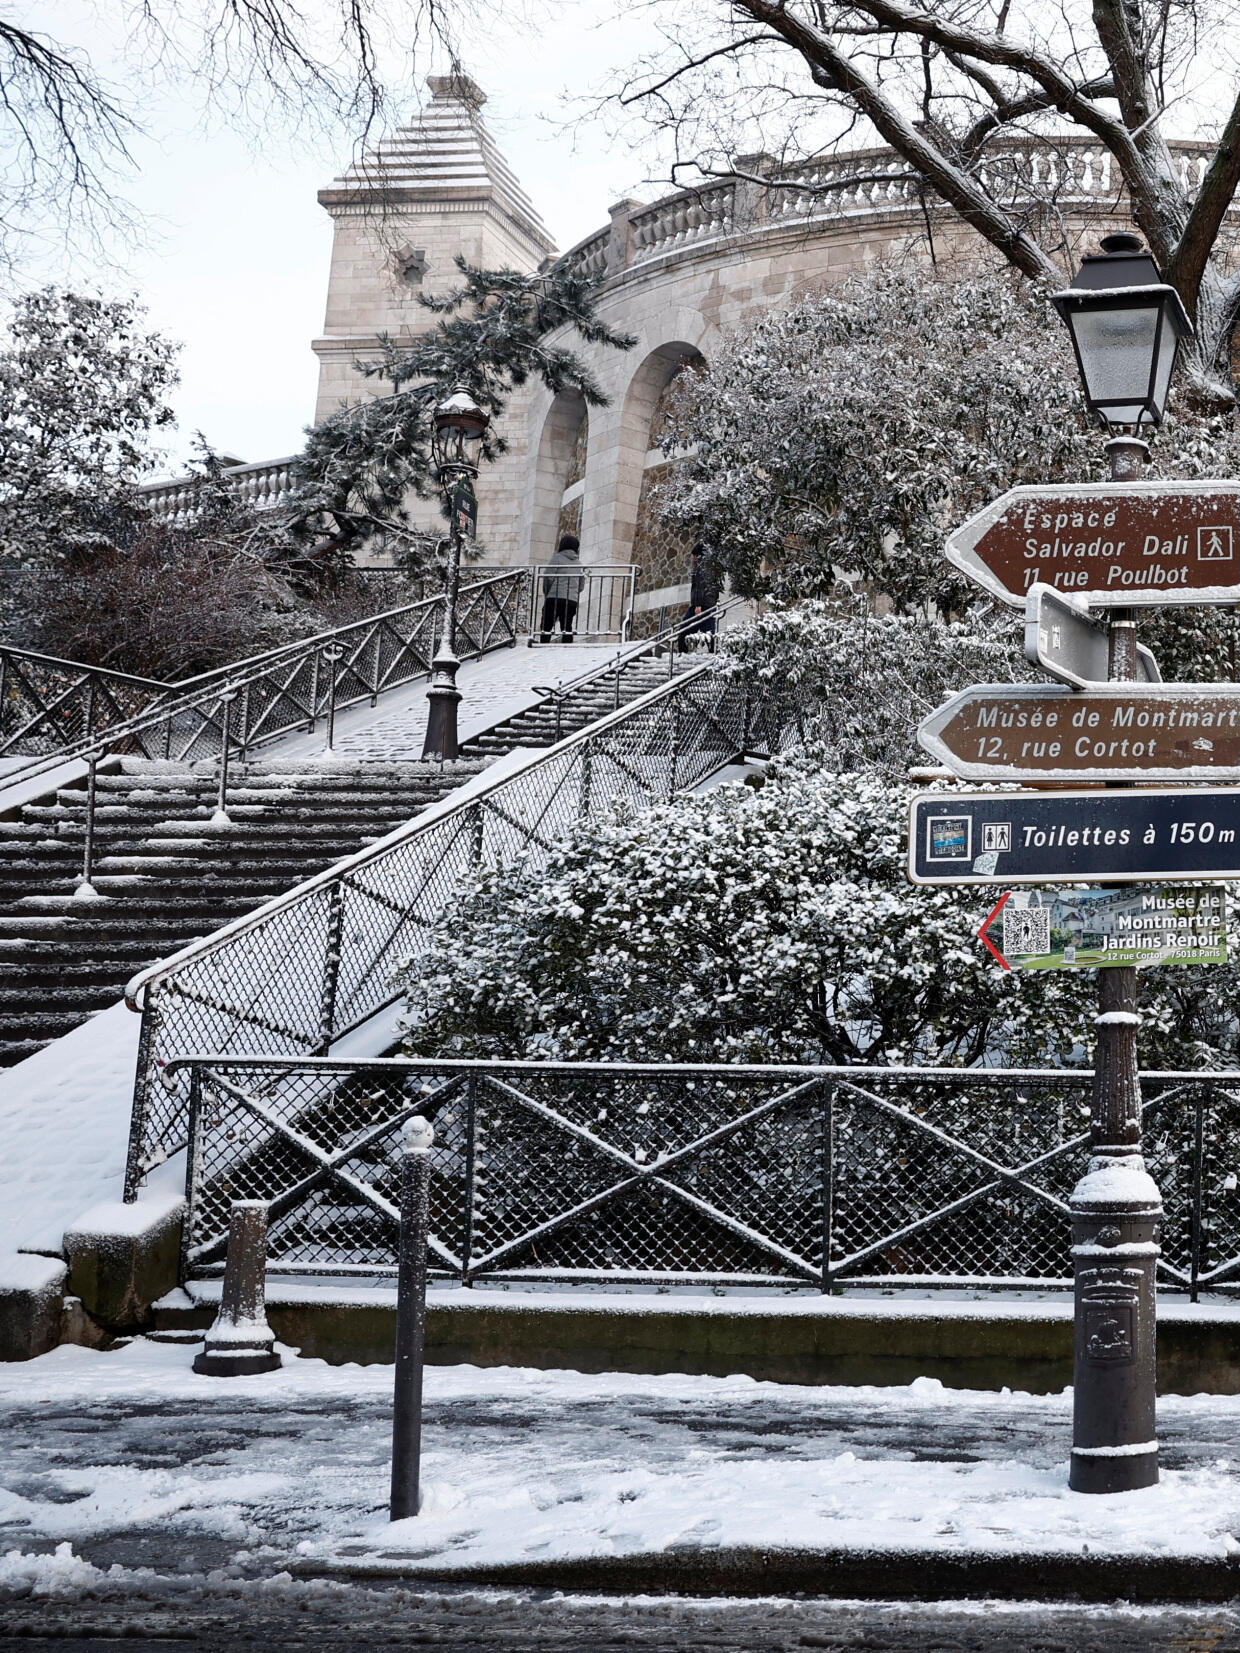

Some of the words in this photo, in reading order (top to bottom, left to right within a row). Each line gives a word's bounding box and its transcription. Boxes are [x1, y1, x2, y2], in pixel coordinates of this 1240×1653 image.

[1023, 508, 1117, 533] Espace
[1023, 537, 1125, 558] Salvador
[1142, 534, 1189, 556] Dali
[1022, 567, 1041, 588] 11
[1053, 570, 1089, 587] rue
[1106, 564, 1189, 585] Poulbot
[976, 706, 1059, 728] Musée
[1071, 706, 1101, 727] de
[976, 736, 1009, 761] 12,
[1020, 742, 1062, 757] rue
[1074, 736, 1158, 758] Cortot
[1022, 825, 1132, 848] Toilettes
[1142, 823, 1157, 845] à
[1142, 893, 1195, 910] Musée
[1200, 893, 1220, 908] de
[1119, 914, 1221, 930] Montmartre
[1101, 933, 1162, 953] Jardins
[1166, 931, 1221, 948] Renoir
[1107, 952, 1118, 961] 12
[1120, 953, 1135, 961] rue
[1135, 951, 1162, 960] Cortot
[1170, 950, 1198, 958] 75018
[1199, 948, 1221, 957] Paris
